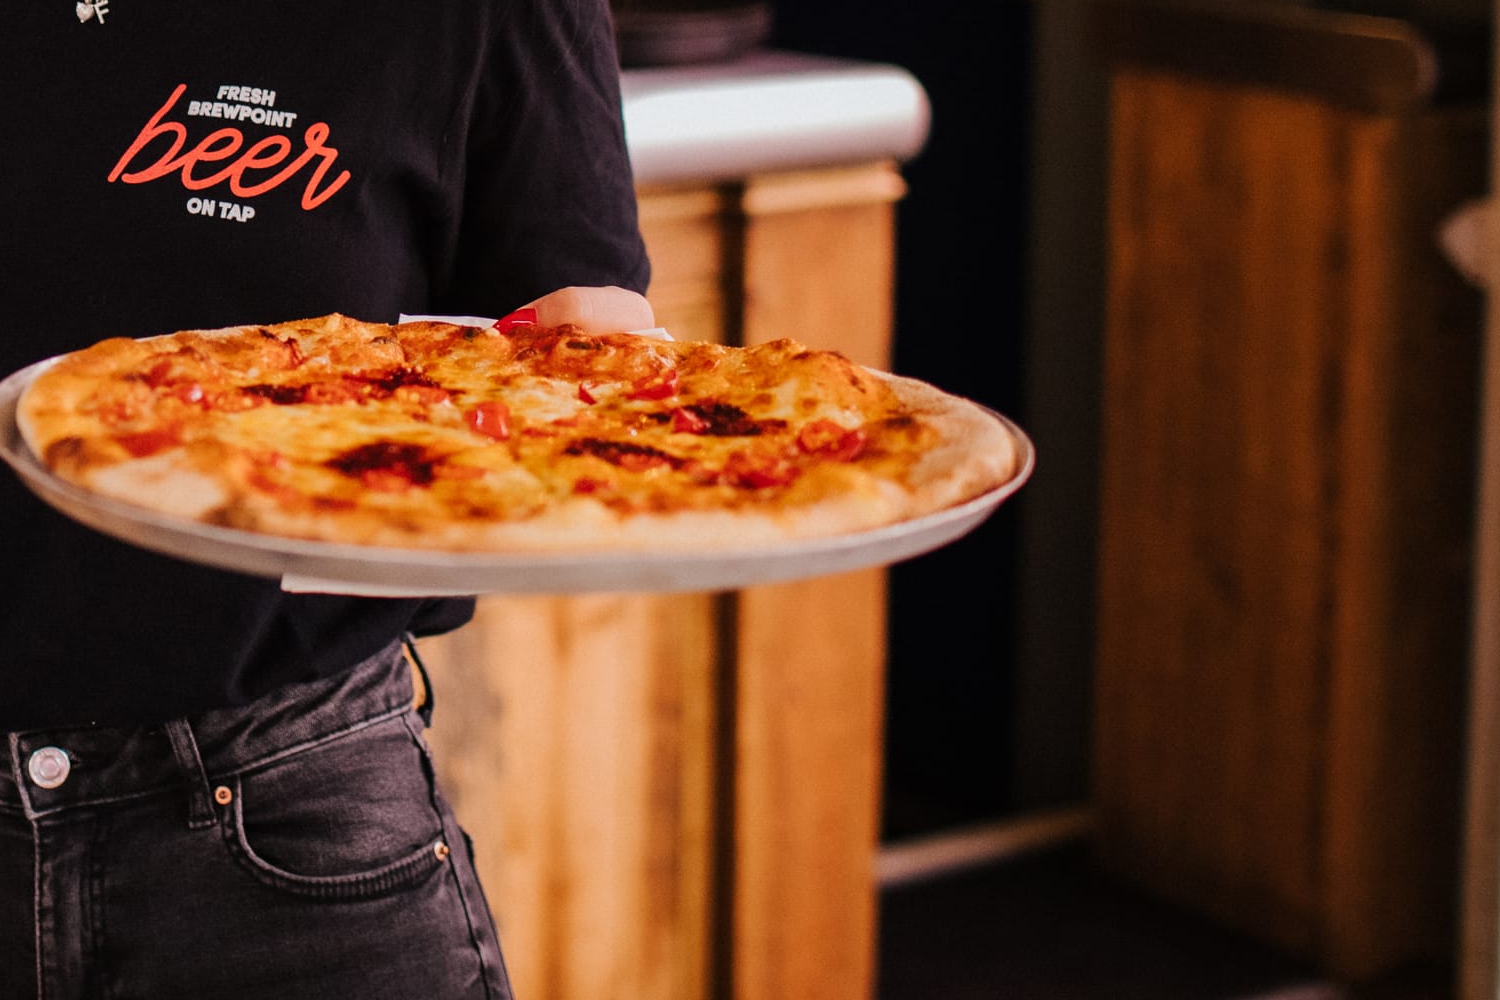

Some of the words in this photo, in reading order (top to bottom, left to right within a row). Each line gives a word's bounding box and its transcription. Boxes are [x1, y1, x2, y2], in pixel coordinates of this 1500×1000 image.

[217, 85, 276, 107] FRESH
[187, 101, 297, 128] BREWPOINT
[107, 83, 351, 211] beer
[186, 197, 216, 217] ON
[218, 202, 256, 223] TAP
